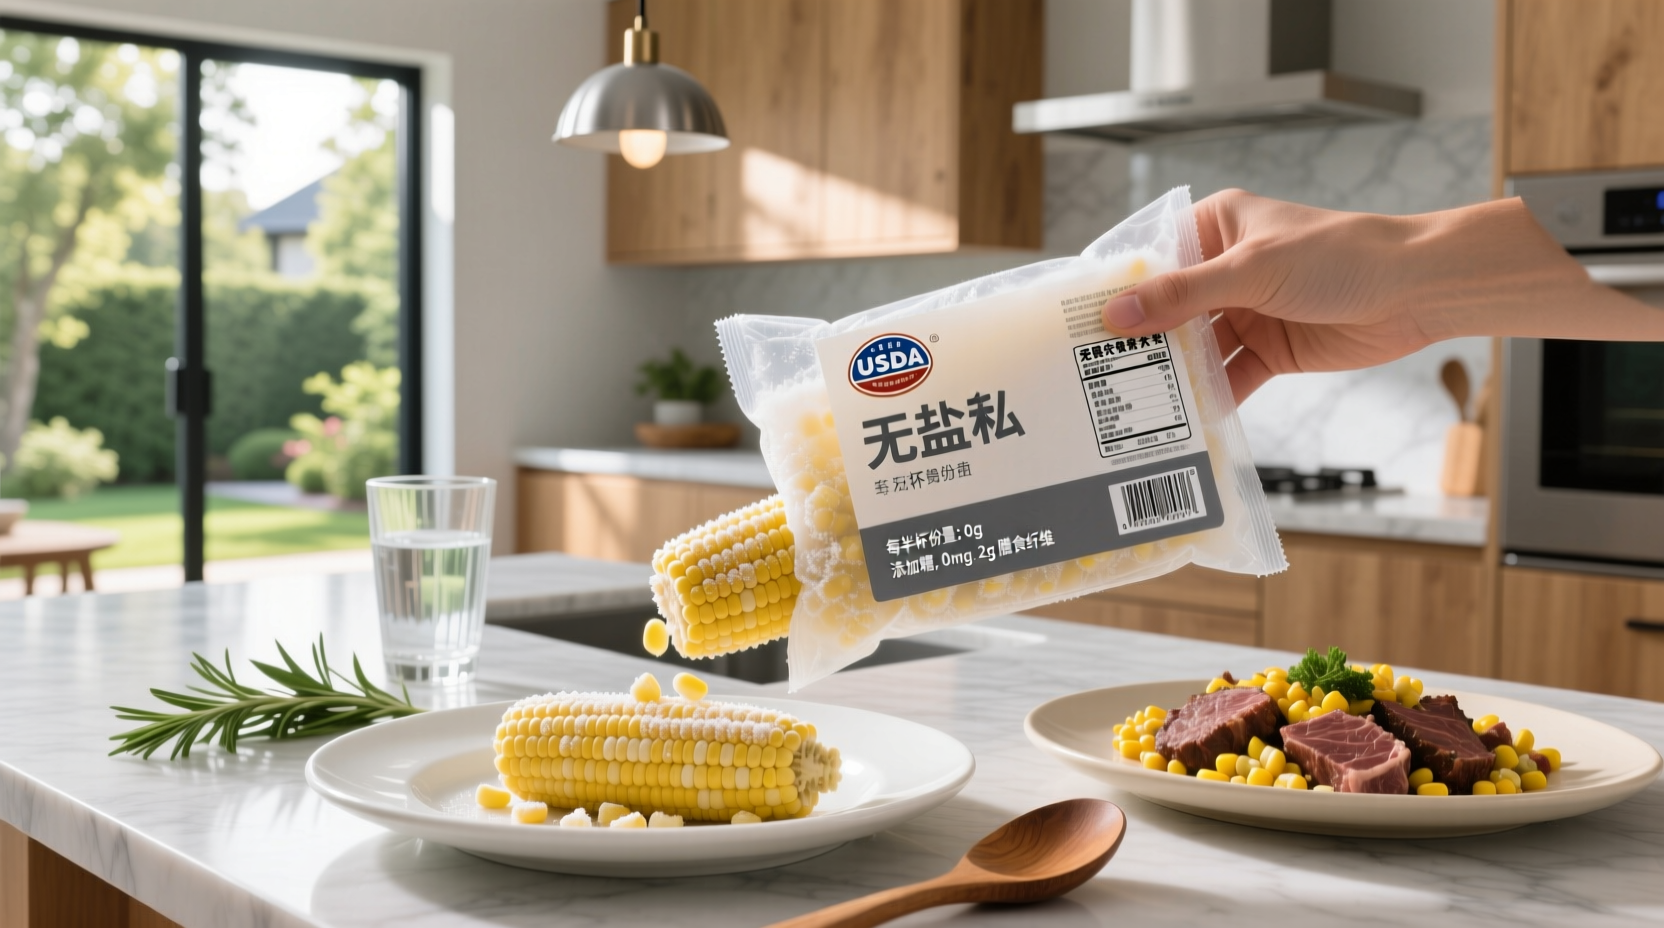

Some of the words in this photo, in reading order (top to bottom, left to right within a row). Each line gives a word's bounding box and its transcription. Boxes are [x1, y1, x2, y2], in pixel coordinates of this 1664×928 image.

[857, 347, 924, 376] USDA
[862, 390, 1026, 470] 无盐私
